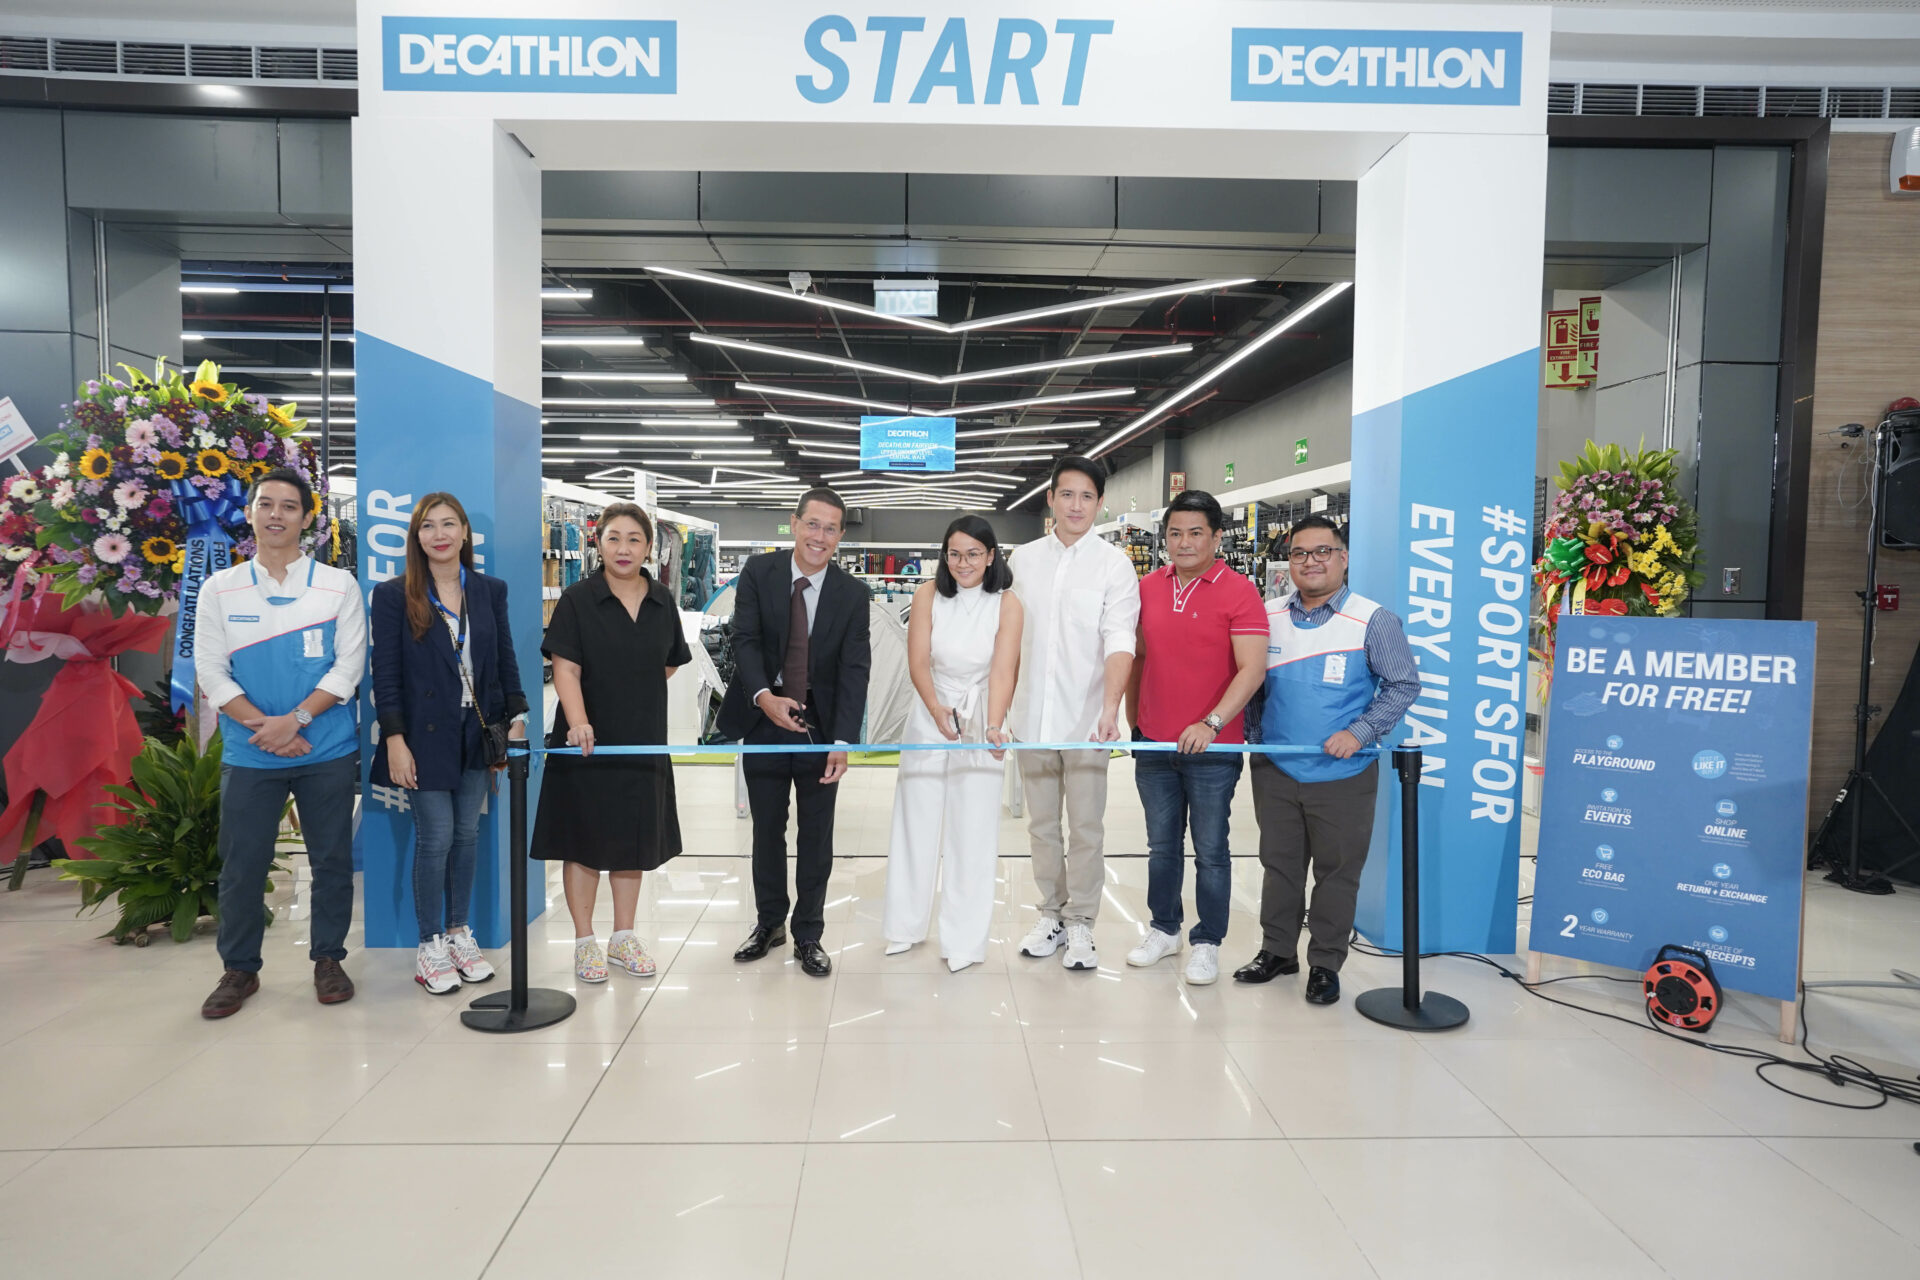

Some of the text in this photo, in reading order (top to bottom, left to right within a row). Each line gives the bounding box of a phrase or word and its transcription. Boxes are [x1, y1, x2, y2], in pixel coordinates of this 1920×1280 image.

[399, 34, 660, 77] DECATHLON
[795, 14, 1115, 106] START
[1248, 44, 1506, 89] DECATHLON
[213, 541, 227, 570] FRO
[179, 539, 205, 659] CONGRATULATIONS
[1470, 504, 1527, 825] #SPORTSFOR
[1567, 647, 1797, 684] BE A MEMBER
[1601, 682, 1752, 714] FOR FREE!
[1573, 753, 1656, 771] PLAYGROUND
[1694, 760, 1726, 770] LIKE IT
[1584, 810, 1632, 825] EVENTS
[1587, 804, 1622, 813] INVITATION
[1715, 818, 1738, 826] SHOP
[1704, 825, 1748, 839] ONLINE
[1595, 862, 1614, 870] FREE
[1582, 868, 1626, 883] ECO BAG
[1677, 882, 1711, 895] RETURN
[1719, 889, 1768, 904] EXCHANGE
[1704, 880, 1740, 891] ONE YEAR
[1560, 914, 1579, 938] 2
[1580, 925, 1596, 933] YEAR
[1597, 928, 1634, 940] WARRANTY
[1693, 940, 1732, 953] DUPLICATE
[1705, 949, 1756, 967] RECEIPTS
